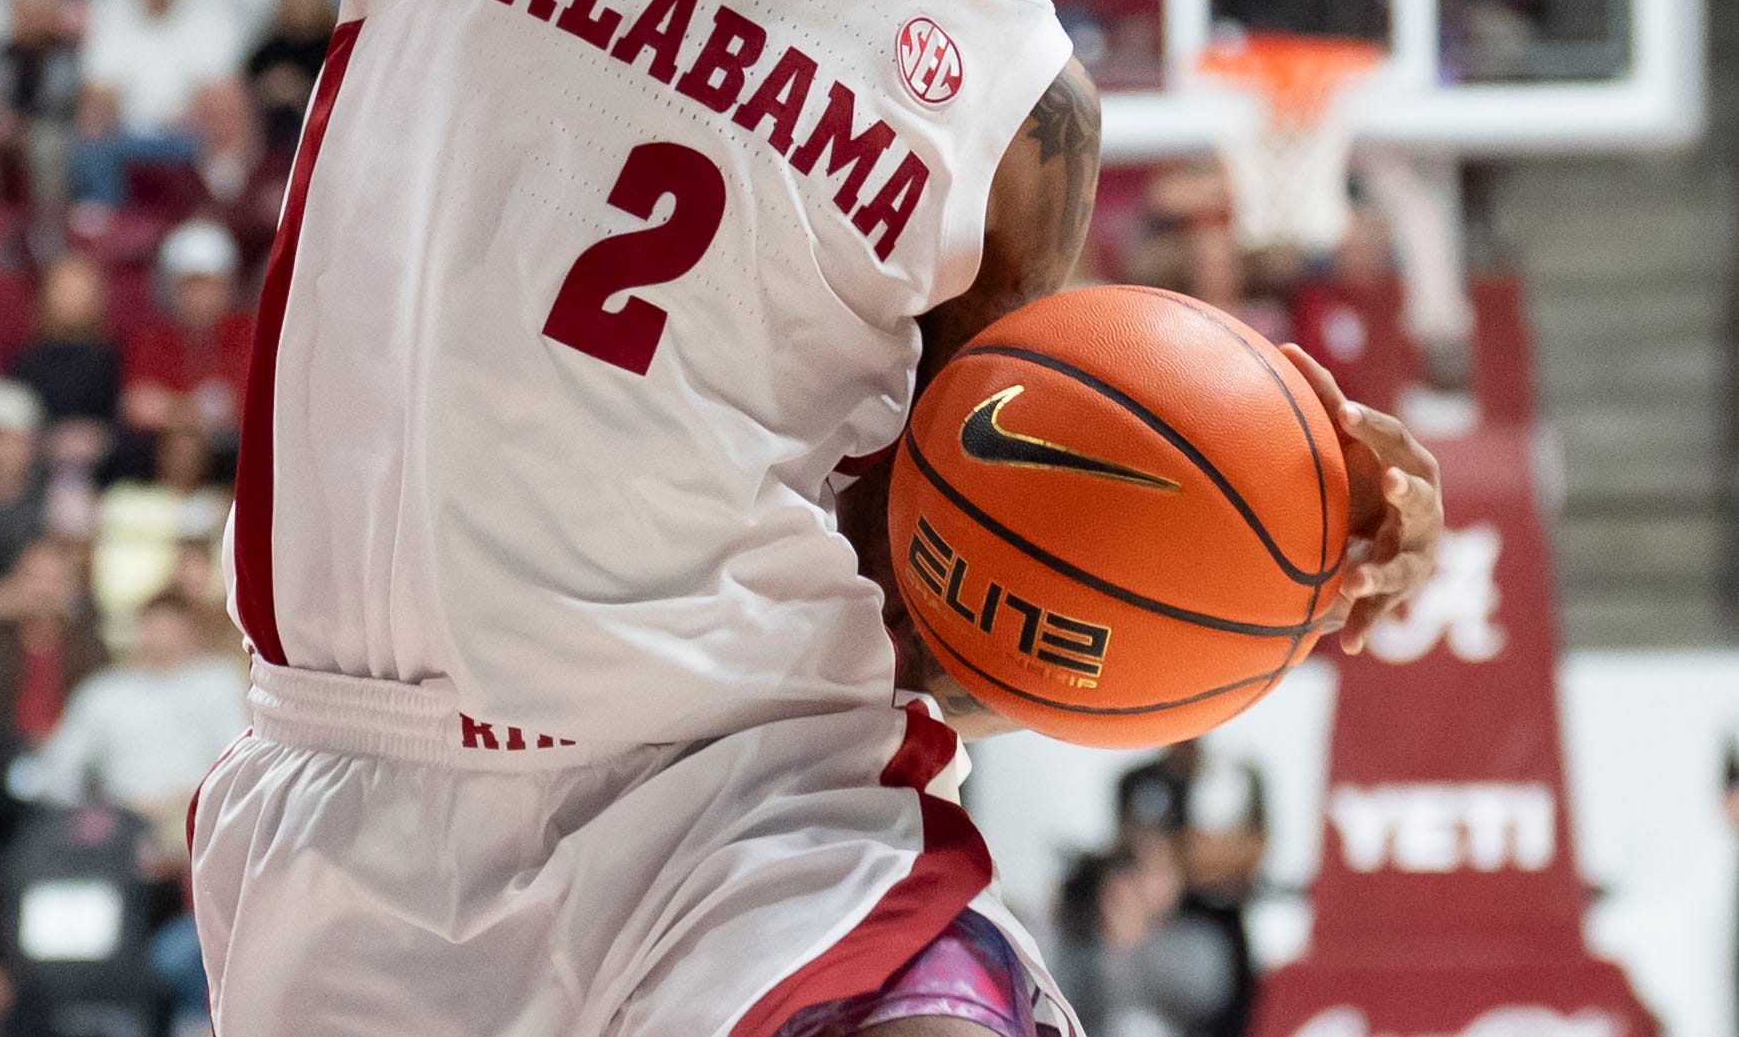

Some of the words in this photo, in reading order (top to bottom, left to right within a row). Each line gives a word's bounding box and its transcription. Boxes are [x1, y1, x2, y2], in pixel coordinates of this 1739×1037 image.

[900, 20, 960, 99] SEC
[542, 141, 726, 376] 2
[907, 514, 1112, 678] ELITE
[1330, 787, 1555, 872] YETI
